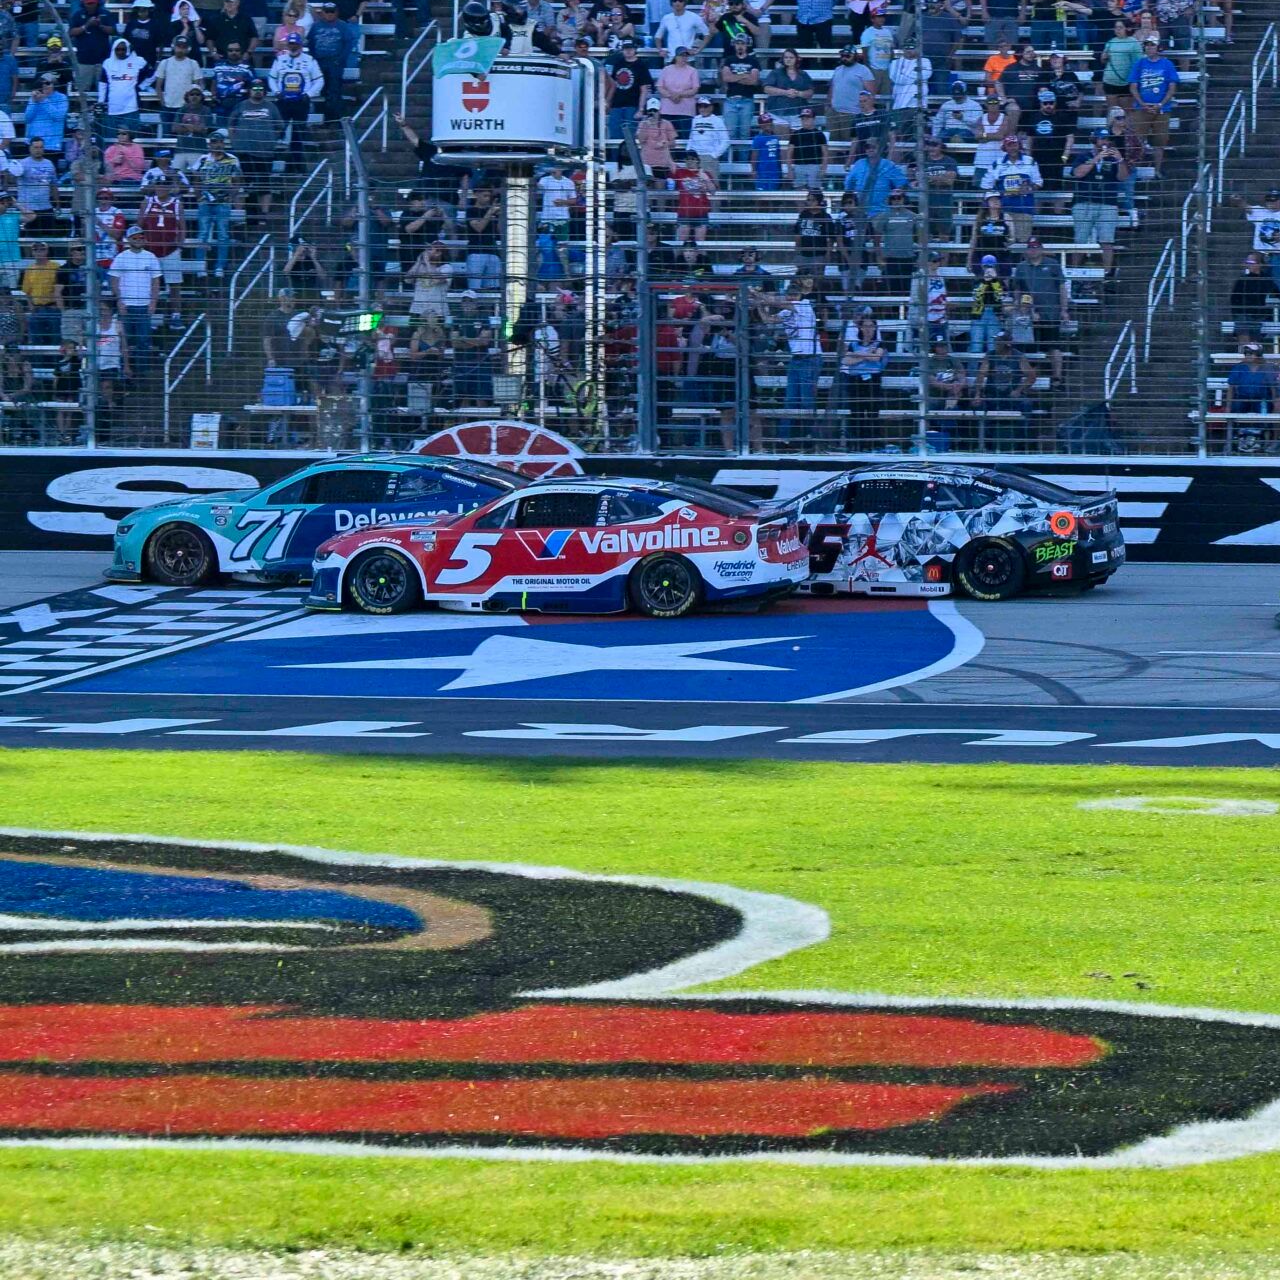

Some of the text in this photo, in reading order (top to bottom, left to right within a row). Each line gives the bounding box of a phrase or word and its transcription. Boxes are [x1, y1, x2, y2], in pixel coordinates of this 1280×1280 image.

[229, 508, 306, 563] 71
[579, 524, 720, 554] Valvoline
[434, 532, 503, 585] 5
[713, 560, 756, 571] Hendrick
[1035, 542, 1077, 564] BEAST
[1052, 564, 1069, 576] QT
